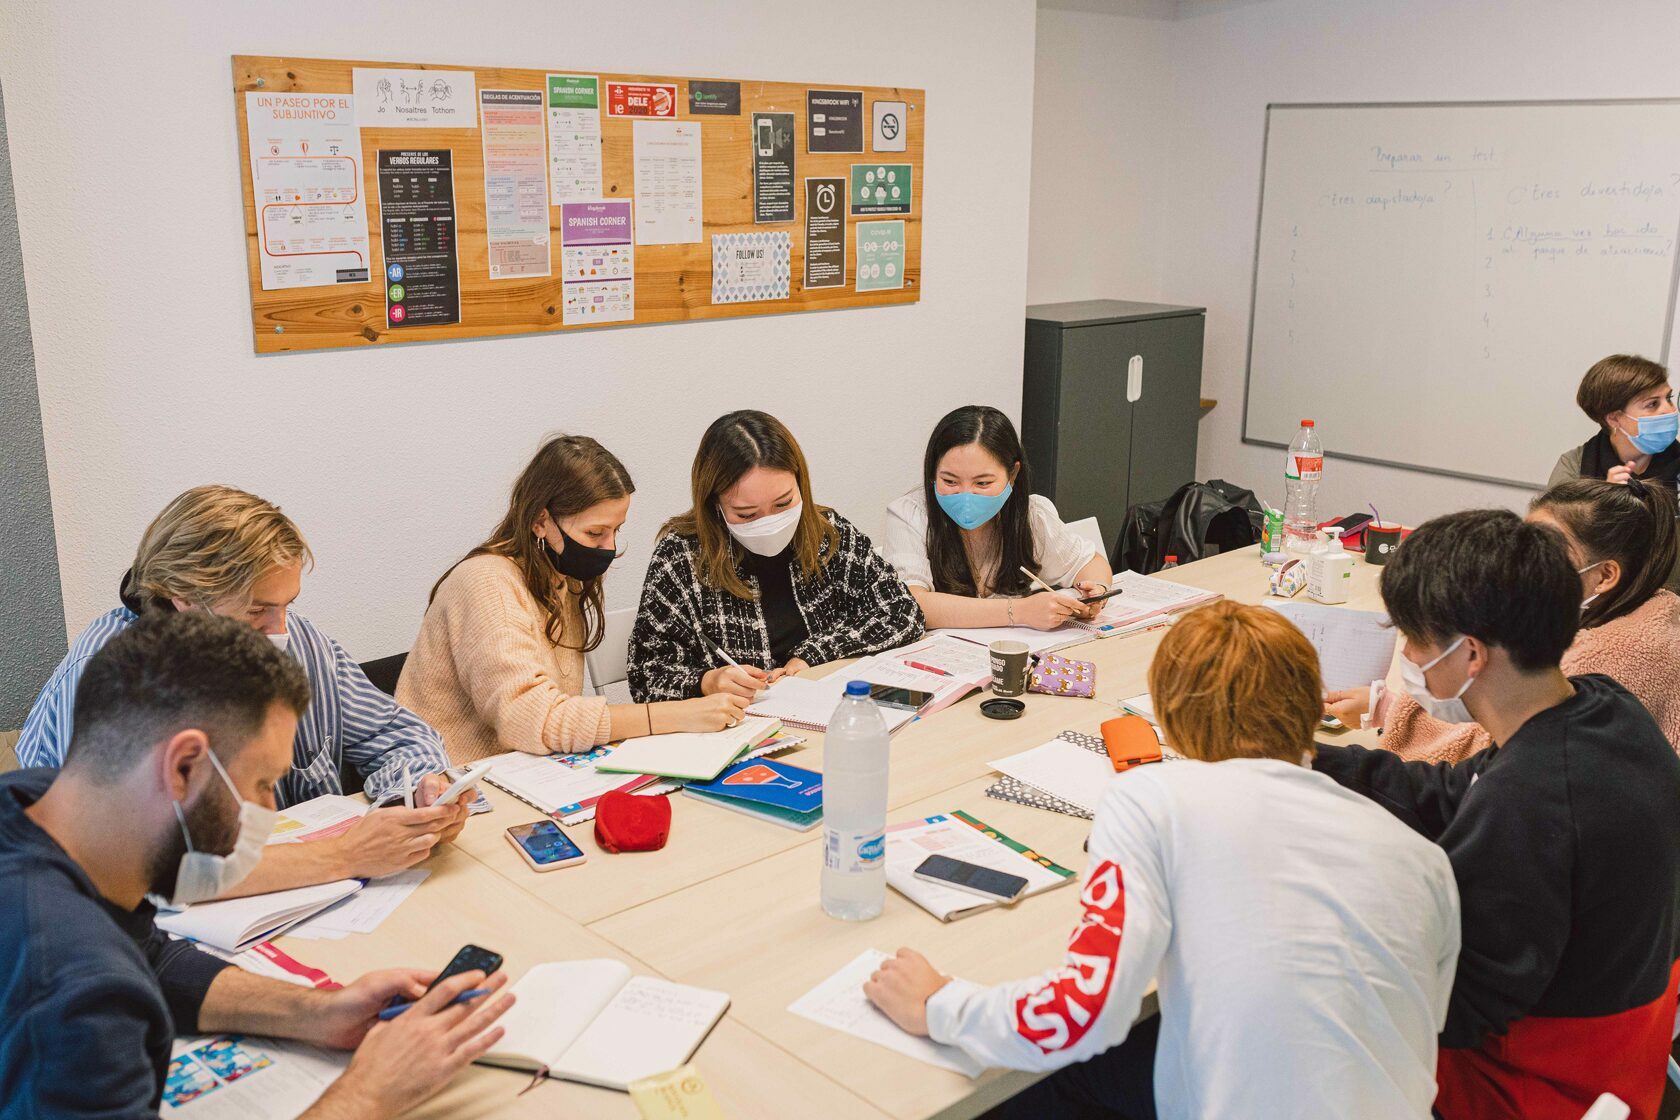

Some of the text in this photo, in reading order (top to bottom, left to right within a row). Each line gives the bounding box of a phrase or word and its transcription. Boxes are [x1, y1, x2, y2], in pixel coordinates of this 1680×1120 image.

[553, 86, 594, 95] SPANISH CORNER
[257, 98, 350, 108] UN PASEO POR EL
[628, 96, 648, 106] DELE
[272, 110, 336, 119] SUBJUNTIVO
[395, 106, 427, 114] Nosaltres
[432, 106, 456, 114] Tothom
[390, 157, 439, 165] VERBOS REGULARES
[1369, 146, 1495, 169] Preparar un test
[568, 216, 627, 226] SPANISH CORNER
[736, 249, 764, 259] FOLLOW US!
[390, 268, 402, 278] -AR
[391, 288, 402, 298] -ER
[392, 308, 402, 318] -IR
